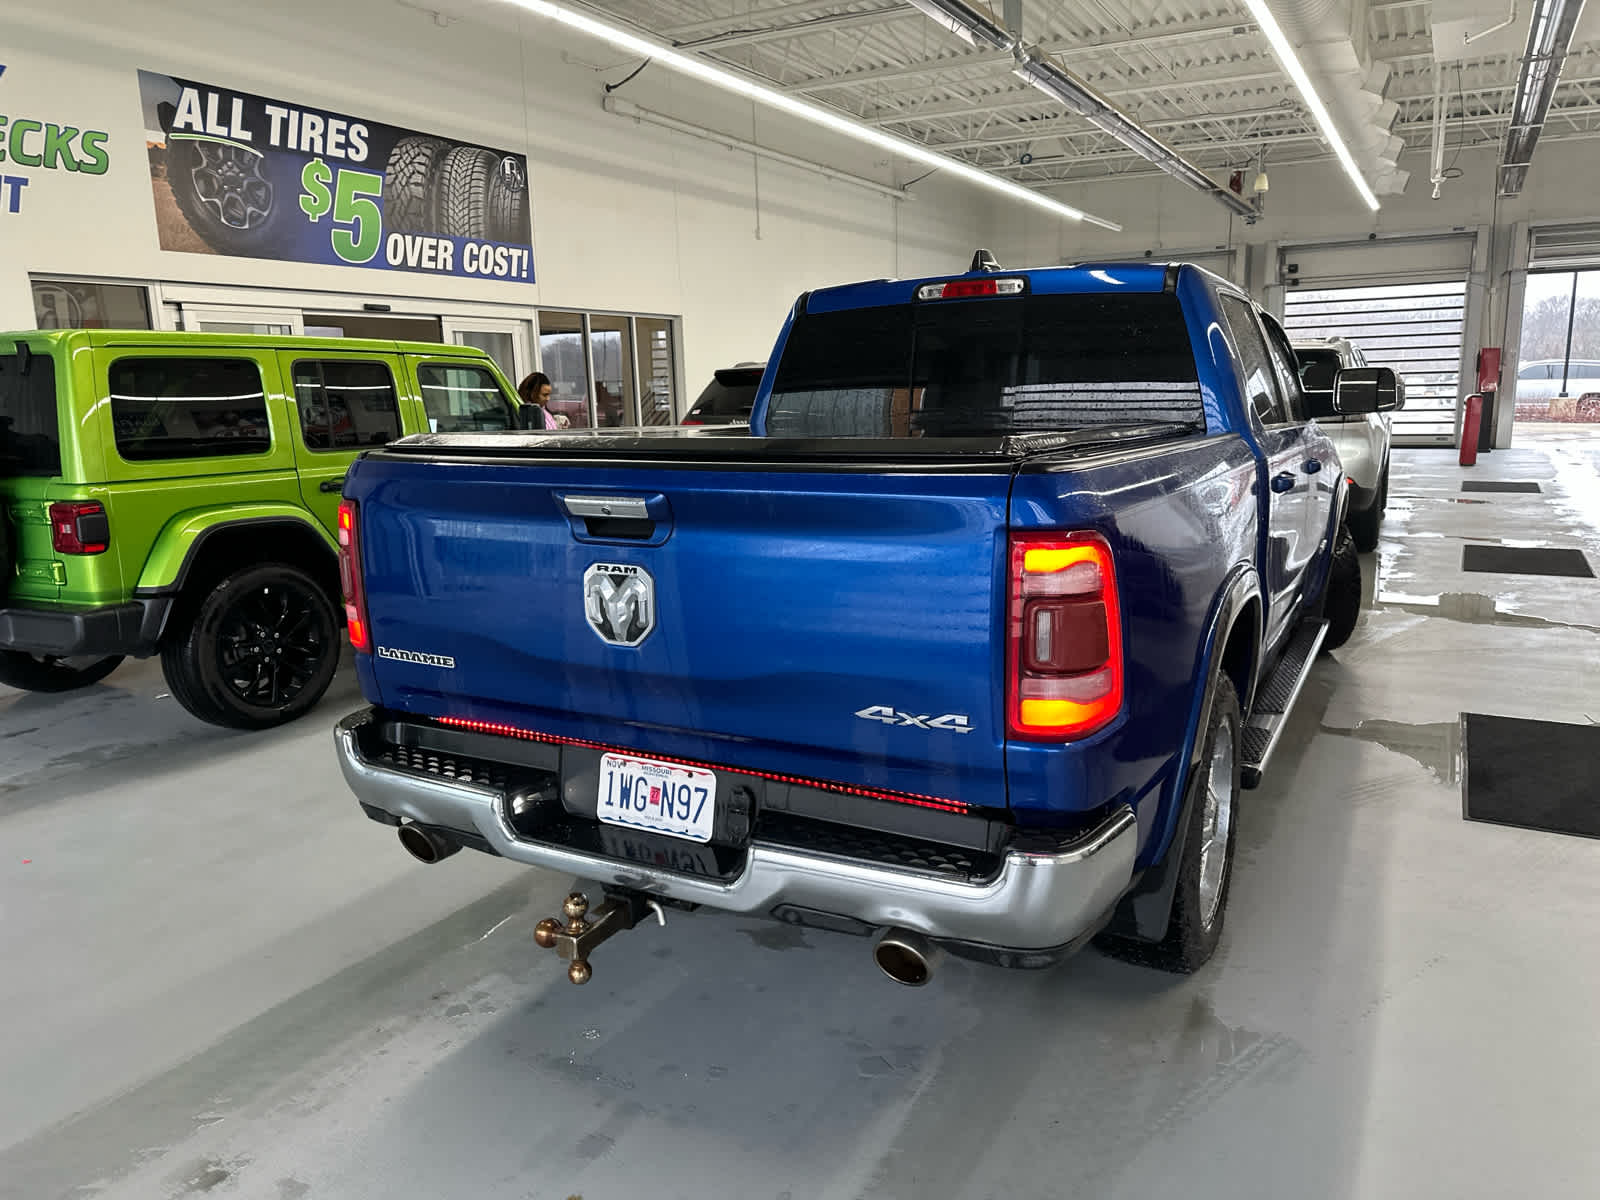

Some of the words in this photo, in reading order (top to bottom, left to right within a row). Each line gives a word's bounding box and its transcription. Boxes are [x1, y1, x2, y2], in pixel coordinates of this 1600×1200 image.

[172, 86, 252, 141] ALL
[264, 104, 369, 162] TIRES
[0, 175, 29, 213] T
[299, 157, 383, 264] $5
[386, 233, 454, 271] OVER
[463, 242, 529, 278] COST!
[596, 564, 638, 574] RAM
[378, 646, 455, 668] LARAMIE
[854, 705, 976, 734] 4x4
[606, 760, 622, 769] NOV
[641, 765, 672, 776] MISSOURI
[605, 770, 648, 812] 1WG
[660, 780, 708, 824] N97
